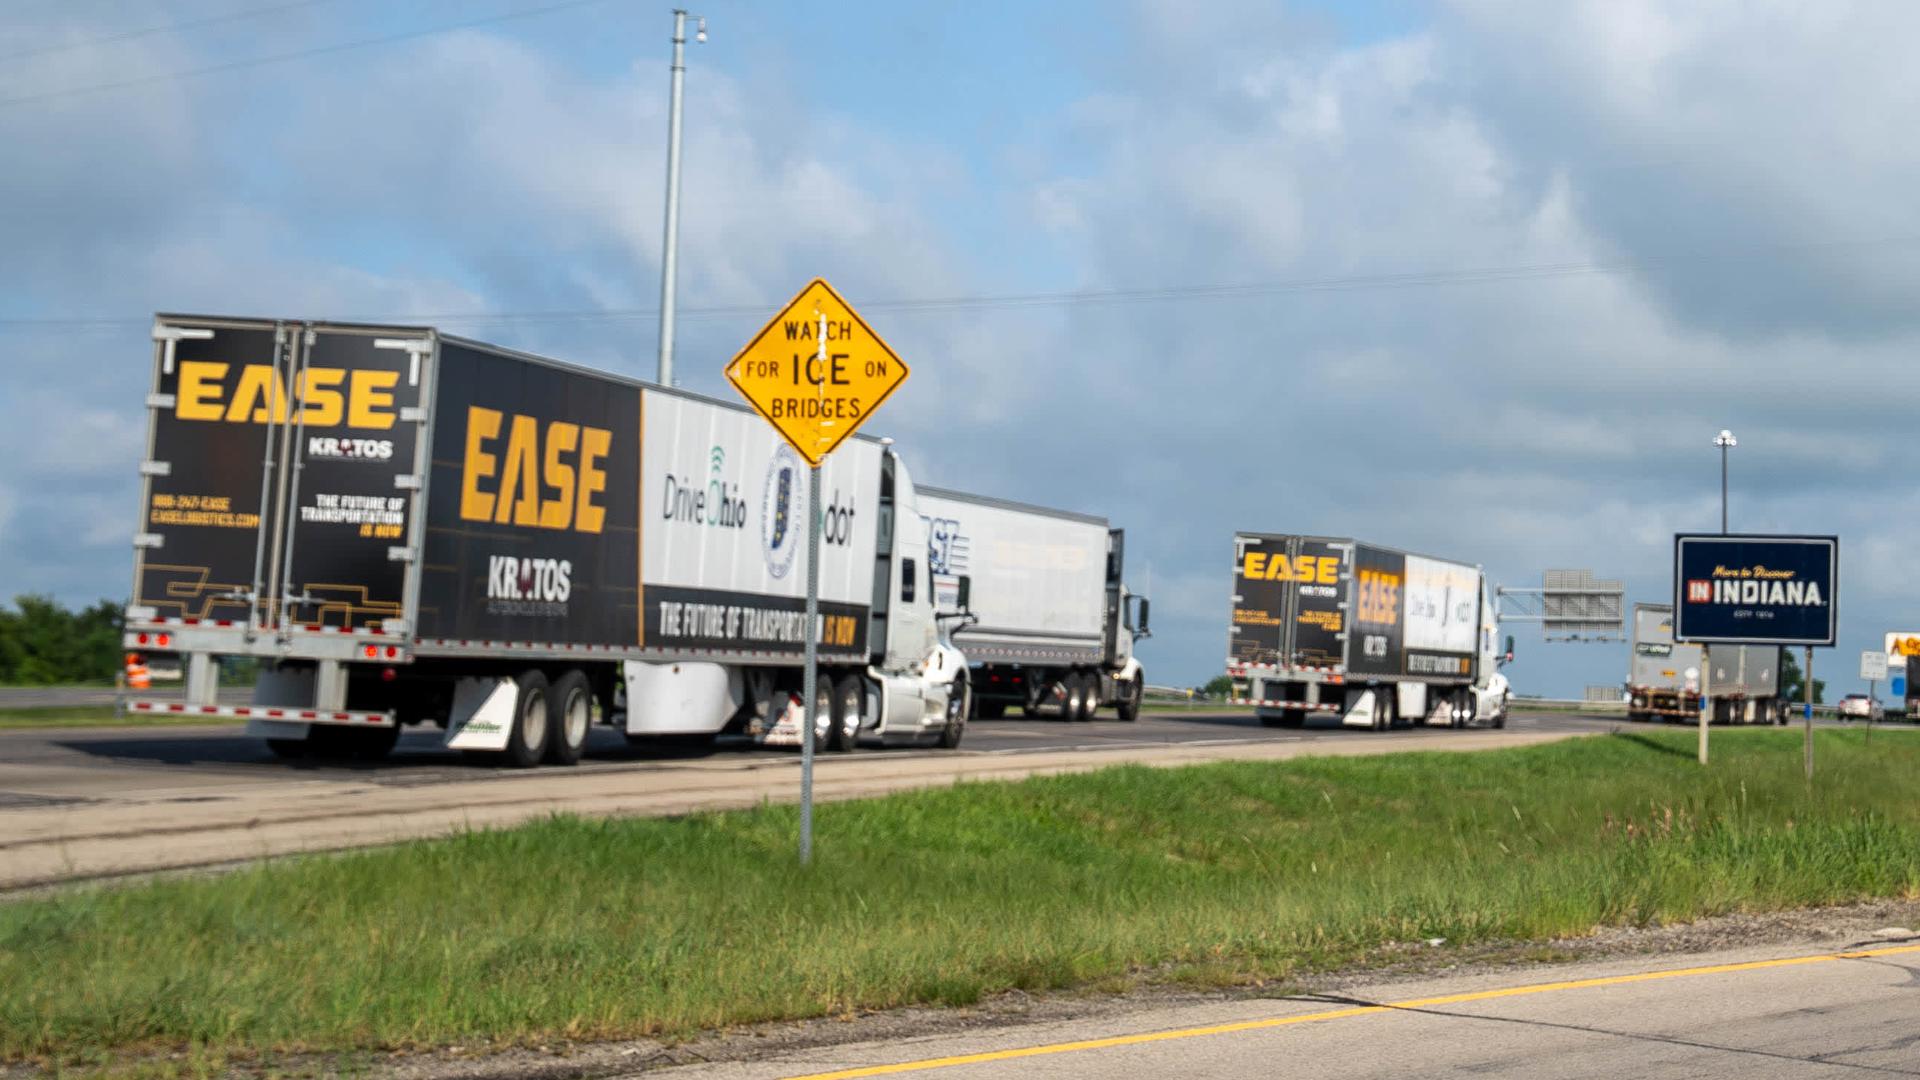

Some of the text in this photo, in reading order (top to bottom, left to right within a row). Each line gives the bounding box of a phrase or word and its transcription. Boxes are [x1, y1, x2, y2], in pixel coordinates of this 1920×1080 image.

[784, 320, 852, 342] WATCH
[746, 353, 888, 386] FOR ICE ON
[175, 360, 401, 431] EASE
[771, 398, 861, 419] BRIDGES
[308, 437, 394, 459] KRATOS
[460, 406, 612, 534] EASE
[301, 507, 404, 524] TRANSPORTATION
[316, 494, 405, 511] THE FUTURE OF
[359, 522, 402, 538] IS NOW
[487, 554, 572, 603] KRATOS
[1243, 552, 1340, 585] EASE
[1711, 564, 1797, 579] More to Discover
[1358, 569, 1399, 625] EASE
[1689, 579, 1823, 606] IN INDIANA
[660, 600, 857, 646] THE FUTURE OF TRANSPORTATN IS NOW
